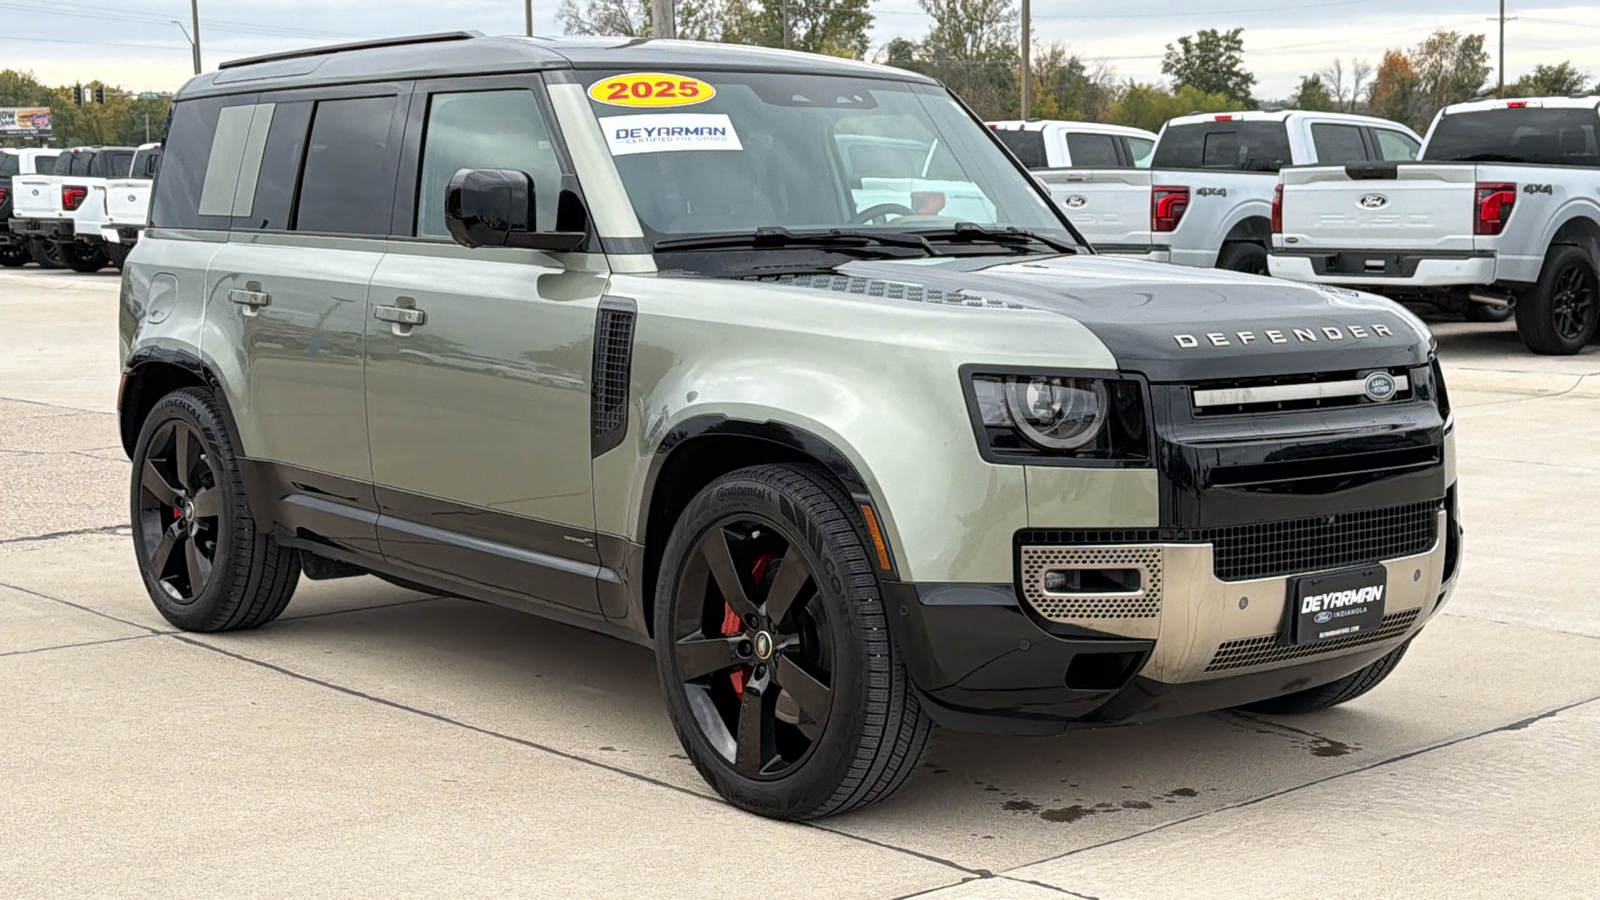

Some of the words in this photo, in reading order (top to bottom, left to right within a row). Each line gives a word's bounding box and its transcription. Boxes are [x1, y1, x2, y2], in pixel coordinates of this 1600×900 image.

[607, 81, 700, 100] 2025
[0, 111, 16, 120] OW
[616, 127, 726, 140] DEYARMAN
[1174, 324, 1393, 348] DEFENDER
[1301, 585, 1384, 614] DEYARMAN
[1333, 607, 1368, 618] INDIANOLA
